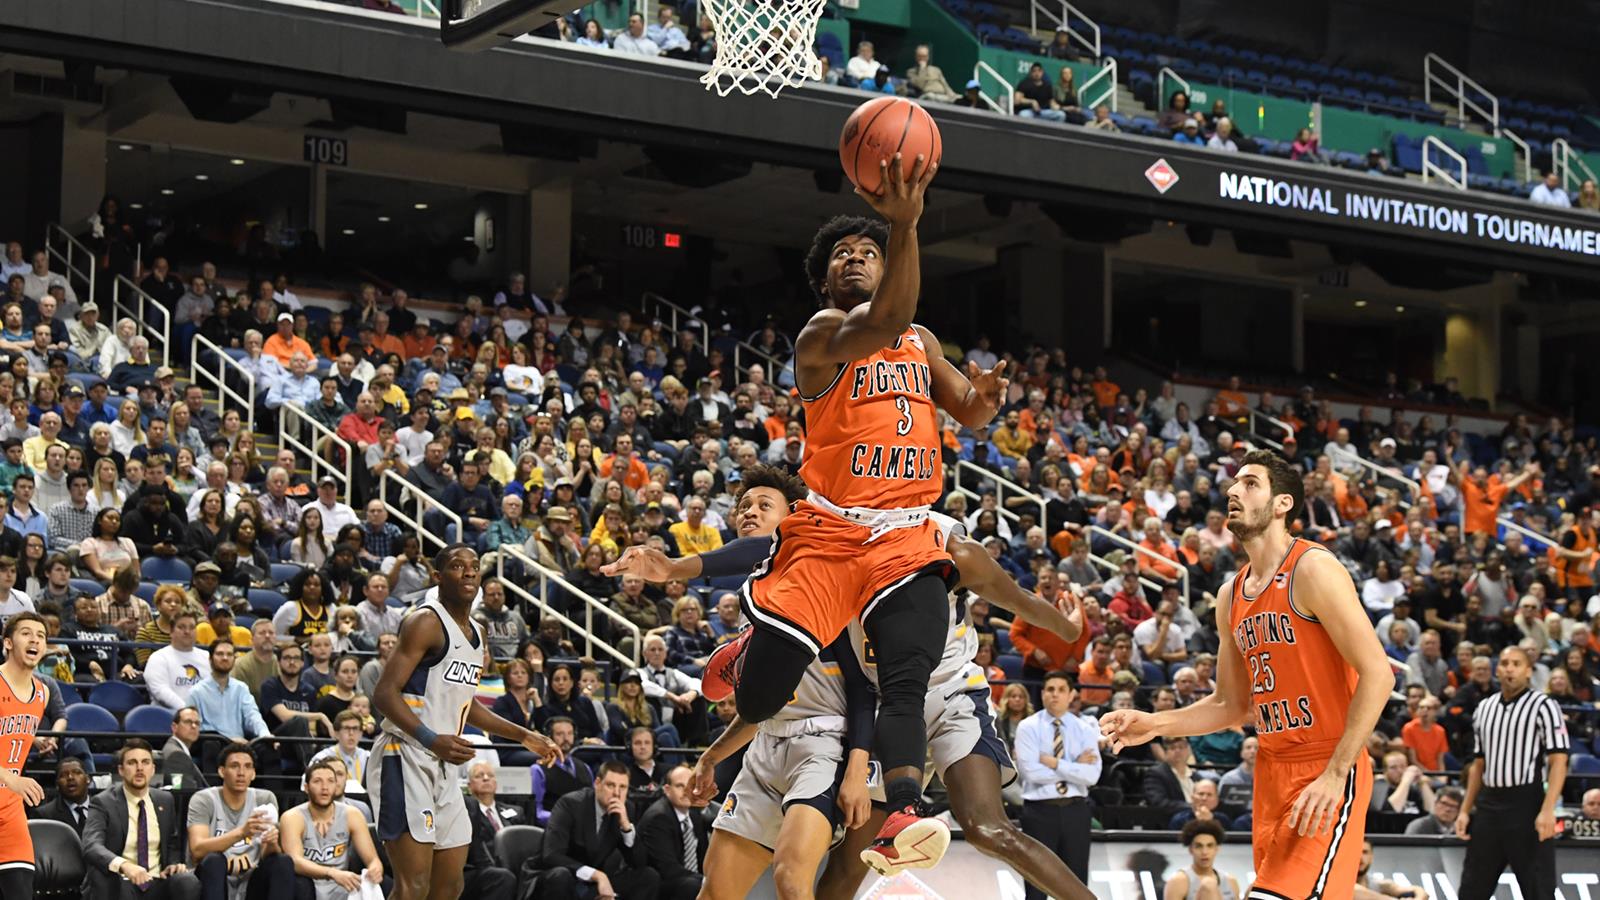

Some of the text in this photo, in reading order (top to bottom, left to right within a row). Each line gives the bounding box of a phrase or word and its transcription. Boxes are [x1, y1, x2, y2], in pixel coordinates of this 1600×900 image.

[306, 138, 345, 163] 109
[1220, 171, 1339, 215] NATIONAL
[1346, 193, 1468, 235] INVITATION
[623, 224, 656, 248] 108
[894, 394, 914, 436] 3
[851, 443, 937, 481] CAMELS
[1235, 611, 1296, 657] GHTING
[1249, 651, 1277, 694] 25
[1256, 695, 1314, 735] MELS
[8, 739, 24, 763] 11
[303, 843, 347, 862] UNCG
